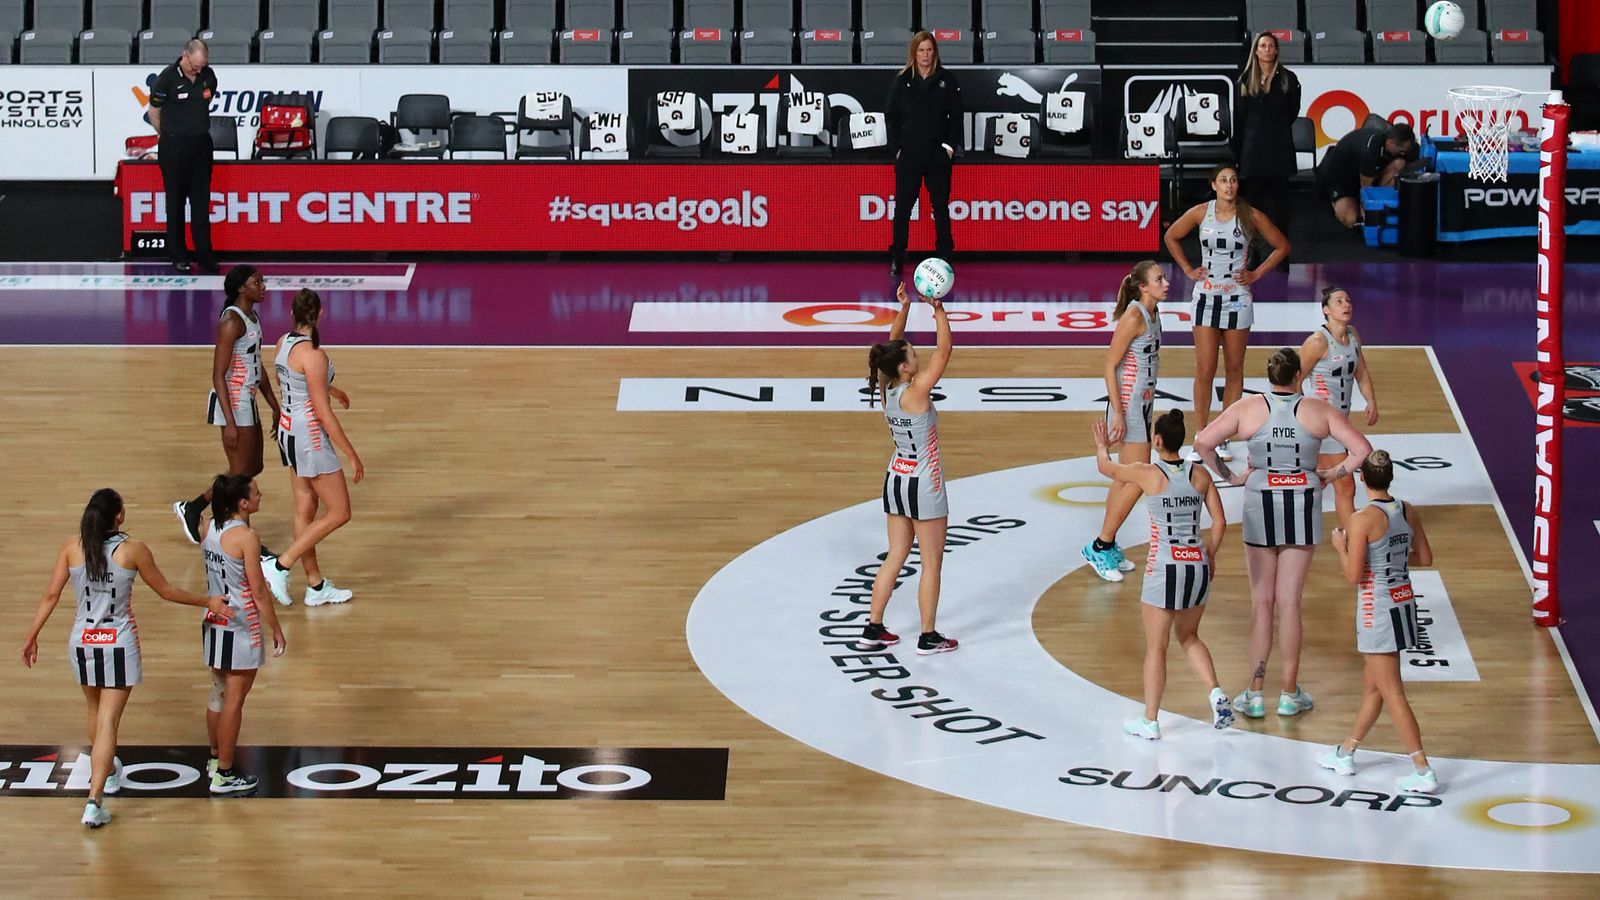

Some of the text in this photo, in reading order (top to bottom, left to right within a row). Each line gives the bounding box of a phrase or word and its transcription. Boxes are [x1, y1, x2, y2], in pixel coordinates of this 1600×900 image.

[297, 191, 472, 224] CENTRE
[548, 190, 769, 231] #squadgoals
[1464, 187, 1600, 209] POWRA
[931, 199, 1091, 221] omeone
[1101, 199, 1159, 229] say
[137, 238, 166, 249] 6:23
[933, 311, 1192, 330] orign
[685, 386, 1292, 402] NISSA
[1272, 427, 1296, 438] RYDE
[1162, 496, 1200, 508] ALTMANN
[1532, 381, 1555, 618] NISSAN
[84, 631, 114, 641] coles
[871, 685, 1047, 745] SHOT
[0, 752, 201, 790] ito
[286, 754, 652, 792] ozito
[1058, 766, 1443, 813] SUNCORP
